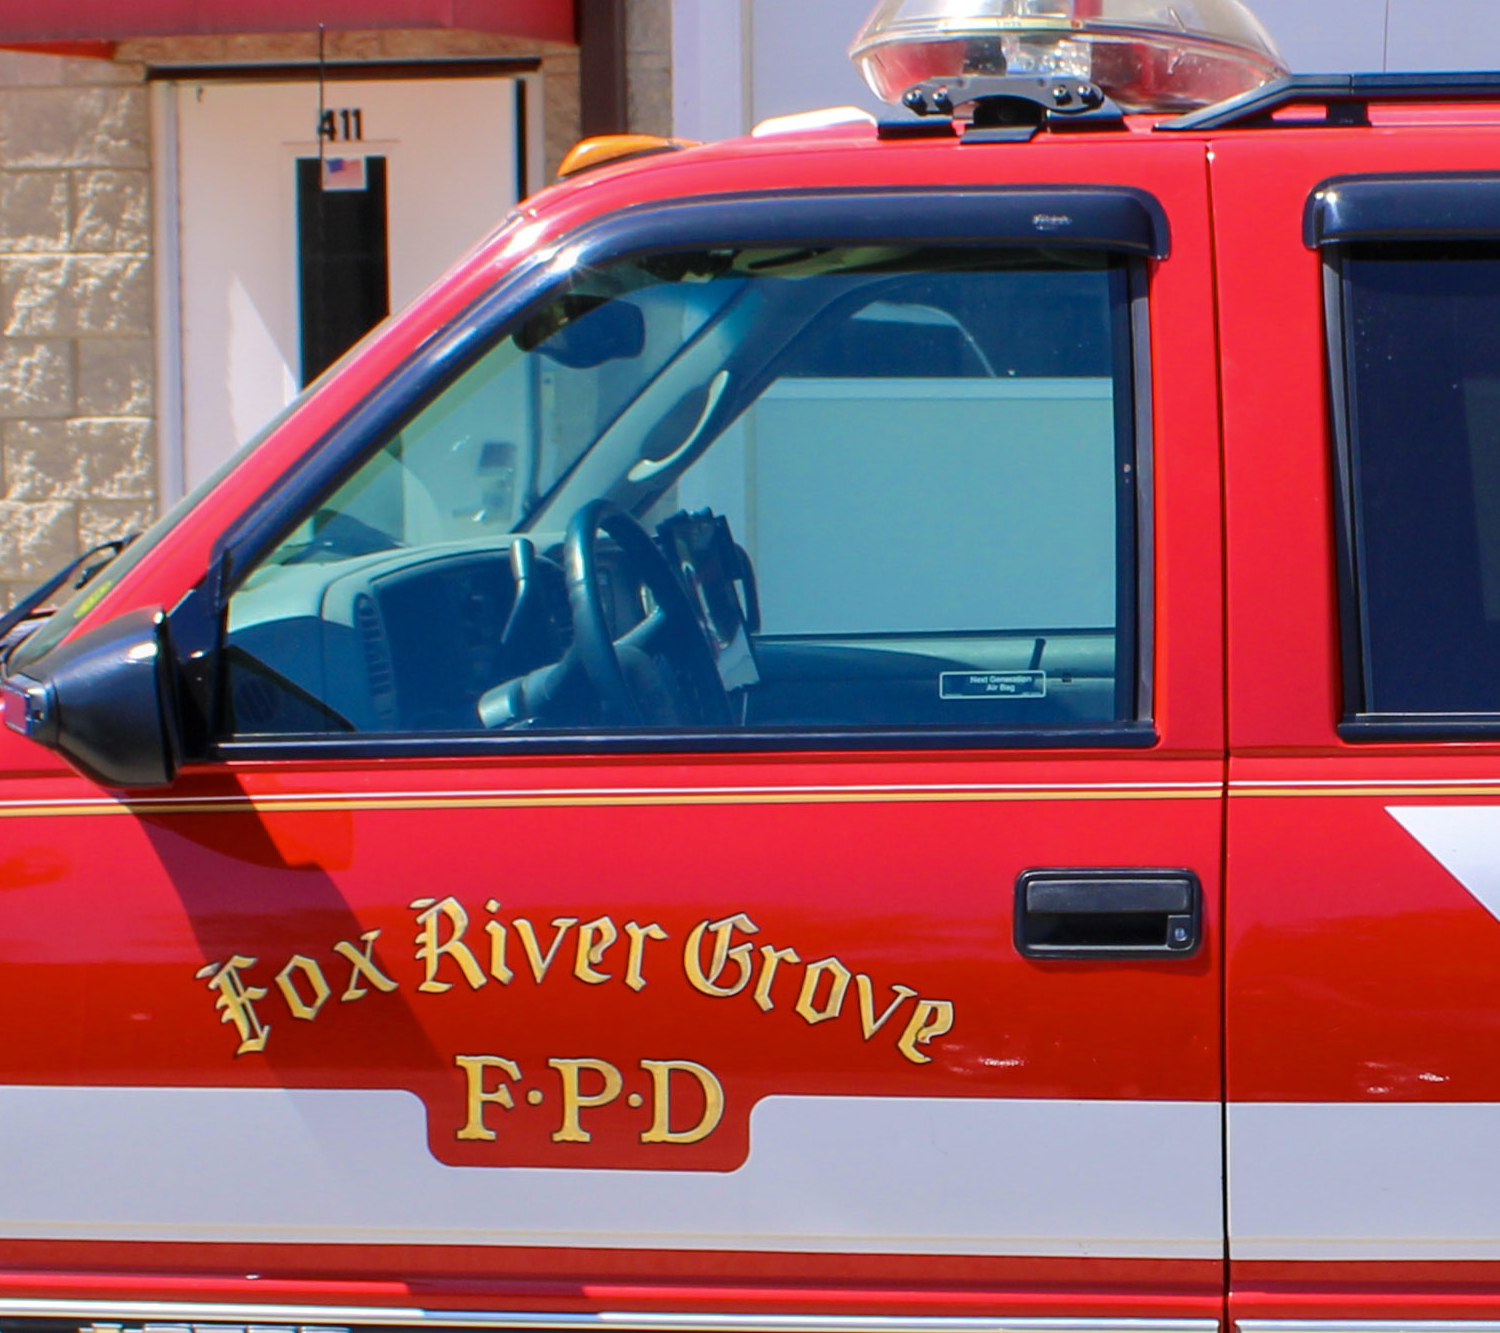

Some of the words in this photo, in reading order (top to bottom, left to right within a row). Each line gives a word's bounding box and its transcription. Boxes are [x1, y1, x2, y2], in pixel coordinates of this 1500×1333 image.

[316, 108, 363, 141] 411
[969, 675, 988, 684] Next
[989, 675, 1032, 684] Generation
[986, 684, 998, 692] Air
[999, 684, 1016, 693] Bag
[195, 928, 399, 1055] Fox
[408, 895, 669, 994] River
[683, 912, 955, 1064] Grove
